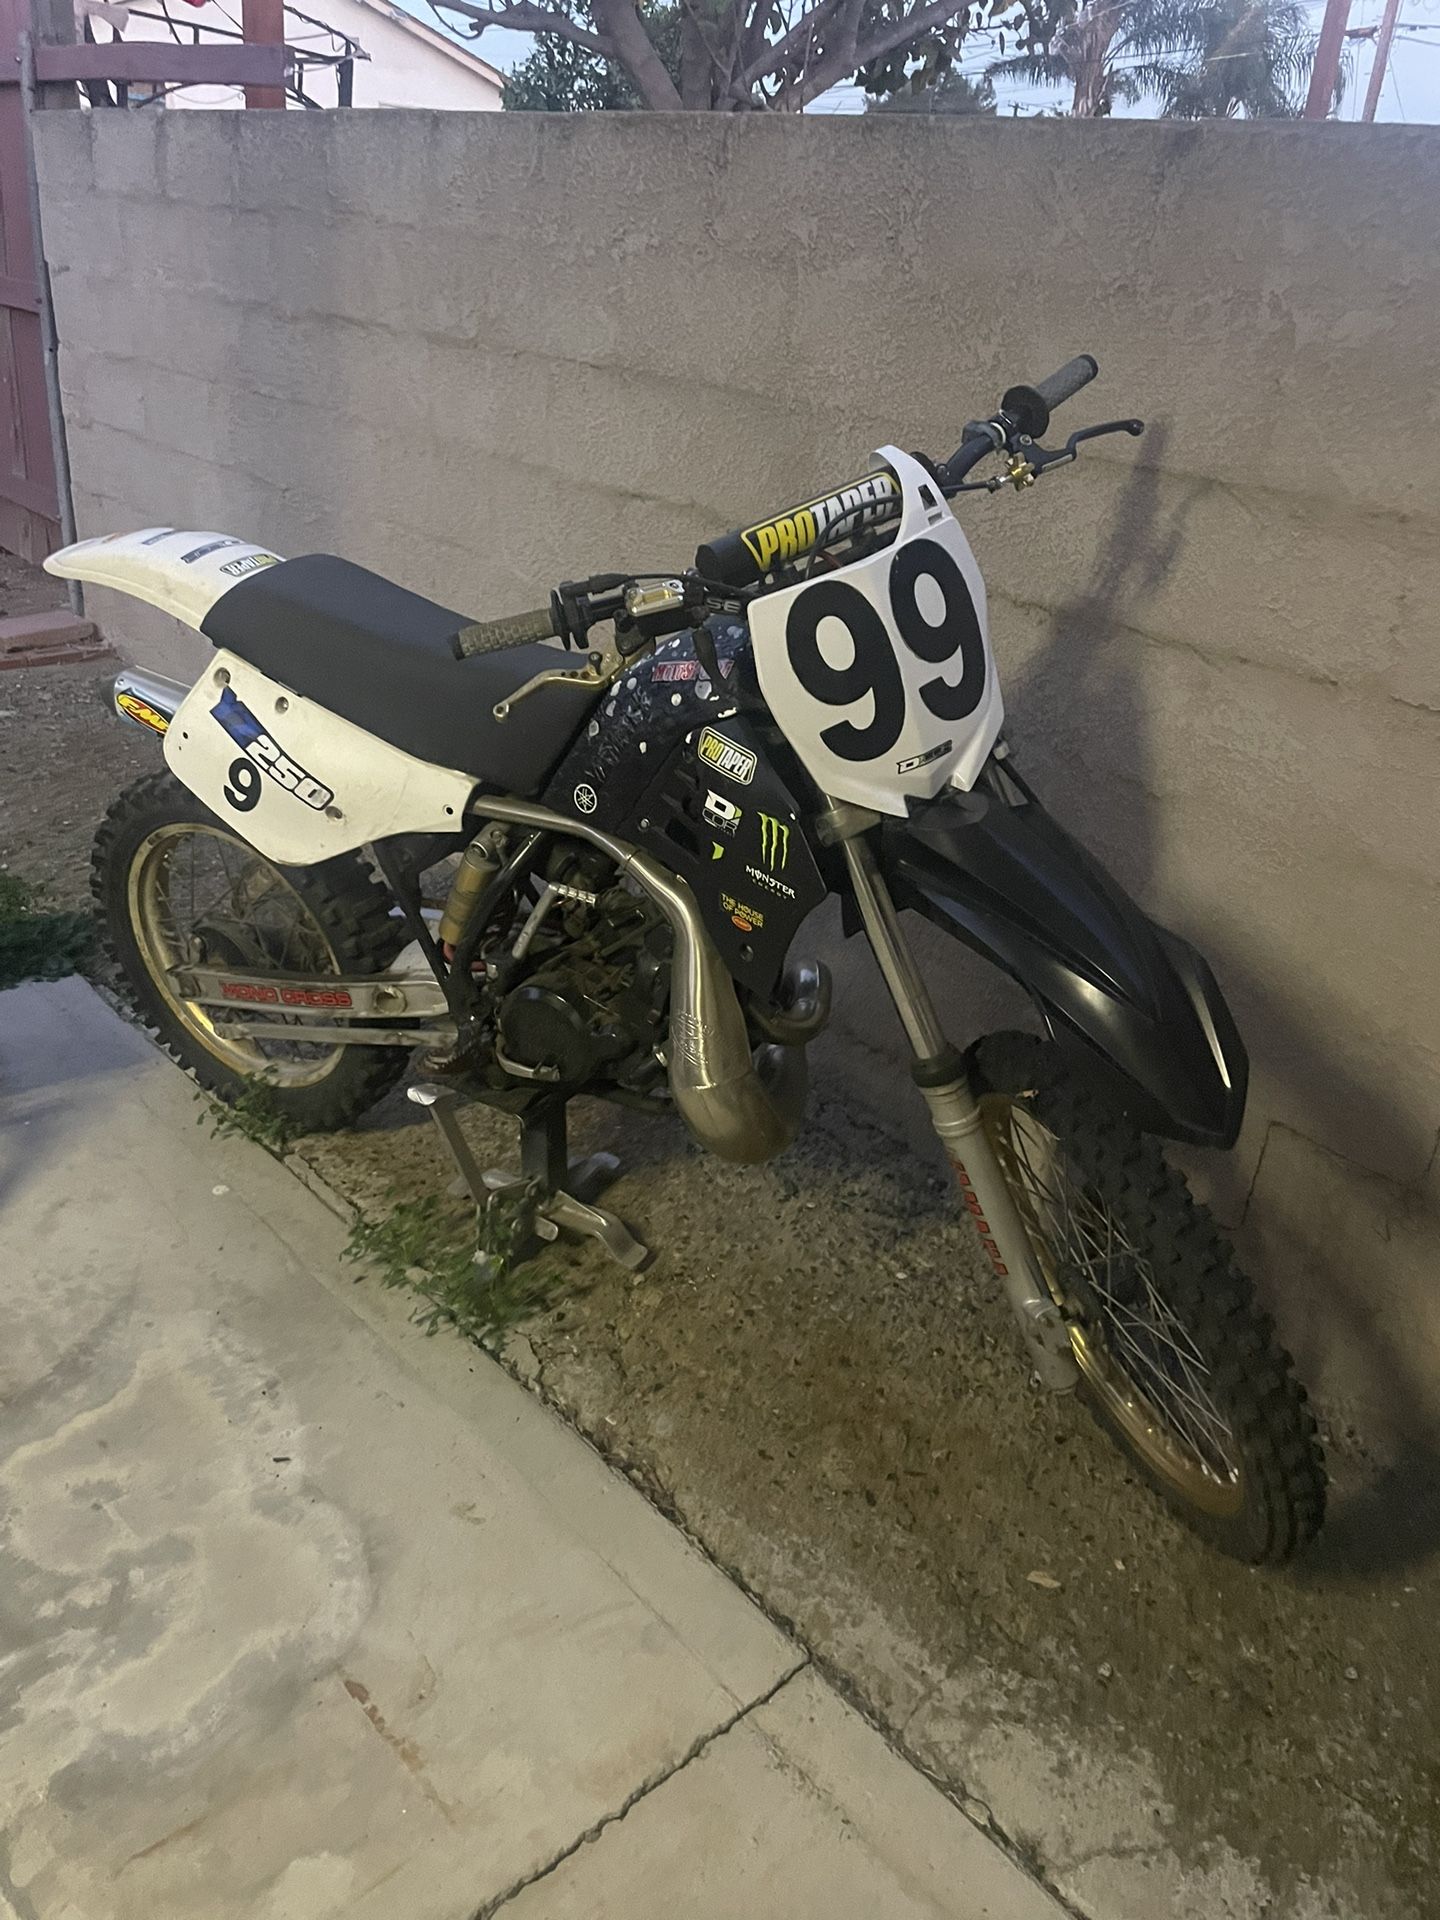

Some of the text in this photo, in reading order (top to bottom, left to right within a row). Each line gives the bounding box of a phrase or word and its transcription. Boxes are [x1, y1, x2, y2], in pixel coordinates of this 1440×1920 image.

[245, 733, 334, 811] 250
[701, 735, 753, 781] PROTAPER
[224, 757, 262, 812] 9
[721, 892, 737, 906] THE
[745, 865, 796, 899] MONSTER
[734, 908, 764, 928] POWER
[281, 987, 352, 1008] CROSS
